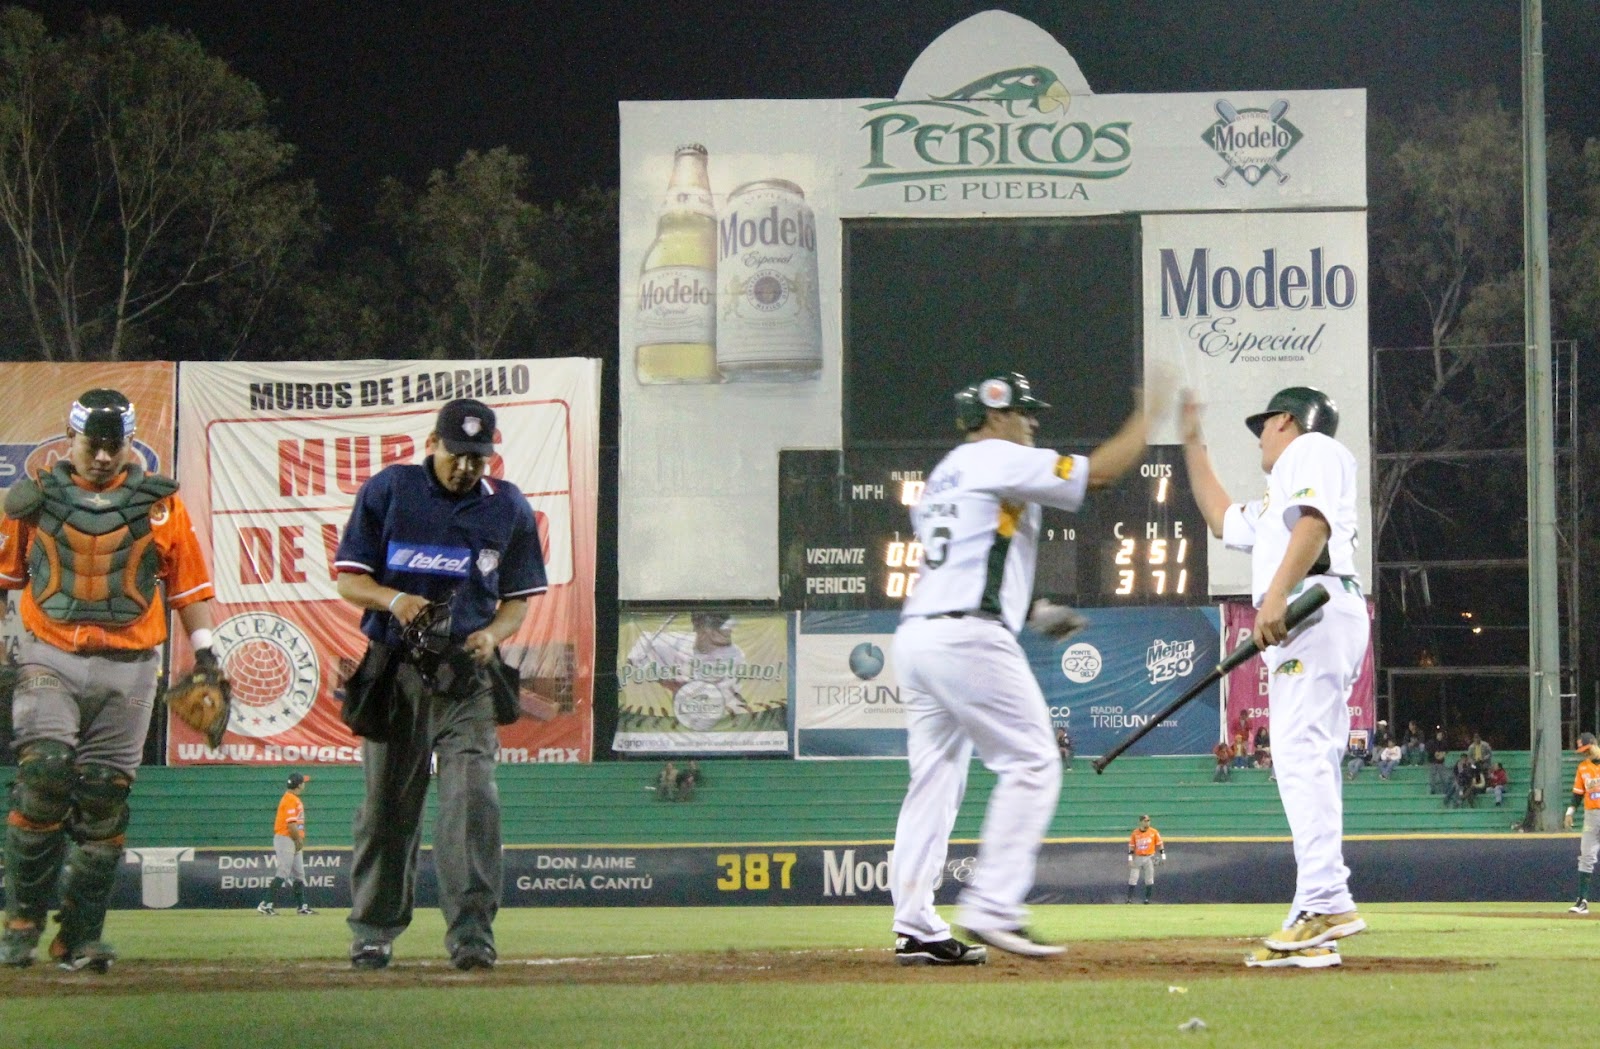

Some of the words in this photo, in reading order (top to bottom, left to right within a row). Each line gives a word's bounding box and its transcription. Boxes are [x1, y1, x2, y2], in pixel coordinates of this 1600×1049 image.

[859, 113, 1133, 169] PERICOS
[1215, 125, 1290, 152] Modelo
[904, 184, 948, 203] DE
[962, 182, 1090, 201] PUEBLA
[719, 206, 817, 262] Modelo
[1159, 246, 1357, 319] Modelo
[641, 278, 710, 311] Modelo
[1188, 317, 1326, 363] Especial
[250, 382, 352, 411] MUROS
[360, 378, 395, 407] DE
[402, 364, 530, 404] LADRILLO
[1140, 464, 1172, 478] OUTS
[852, 484, 884, 500] MPH
[1157, 477, 1168, 502] 1
[1047, 529, 1054, 541] 9
[1063, 529, 1076, 541] 10
[1114, 522, 1124, 539] C
[1146, 522, 1158, 539] H
[1174, 521, 1183, 538] E
[239, 525, 306, 584] DE
[408, 551, 467, 573] telcel
[807, 548, 865, 564] VISITANTE
[807, 577, 866, 594] PERICOS
[1148, 641, 1192, 665] Mejor
[1064, 656, 1100, 672] exa
[811, 685, 904, 706] TRIBUN
[1090, 706, 1123, 714] RADIO
[218, 856, 258, 869] DON
[537, 855, 577, 869] DON
[581, 855, 636, 869] JAIME
[716, 853, 797, 891] 387
[516, 875, 586, 890] GARCÍA
[590, 874, 653, 890] CANTÚ
